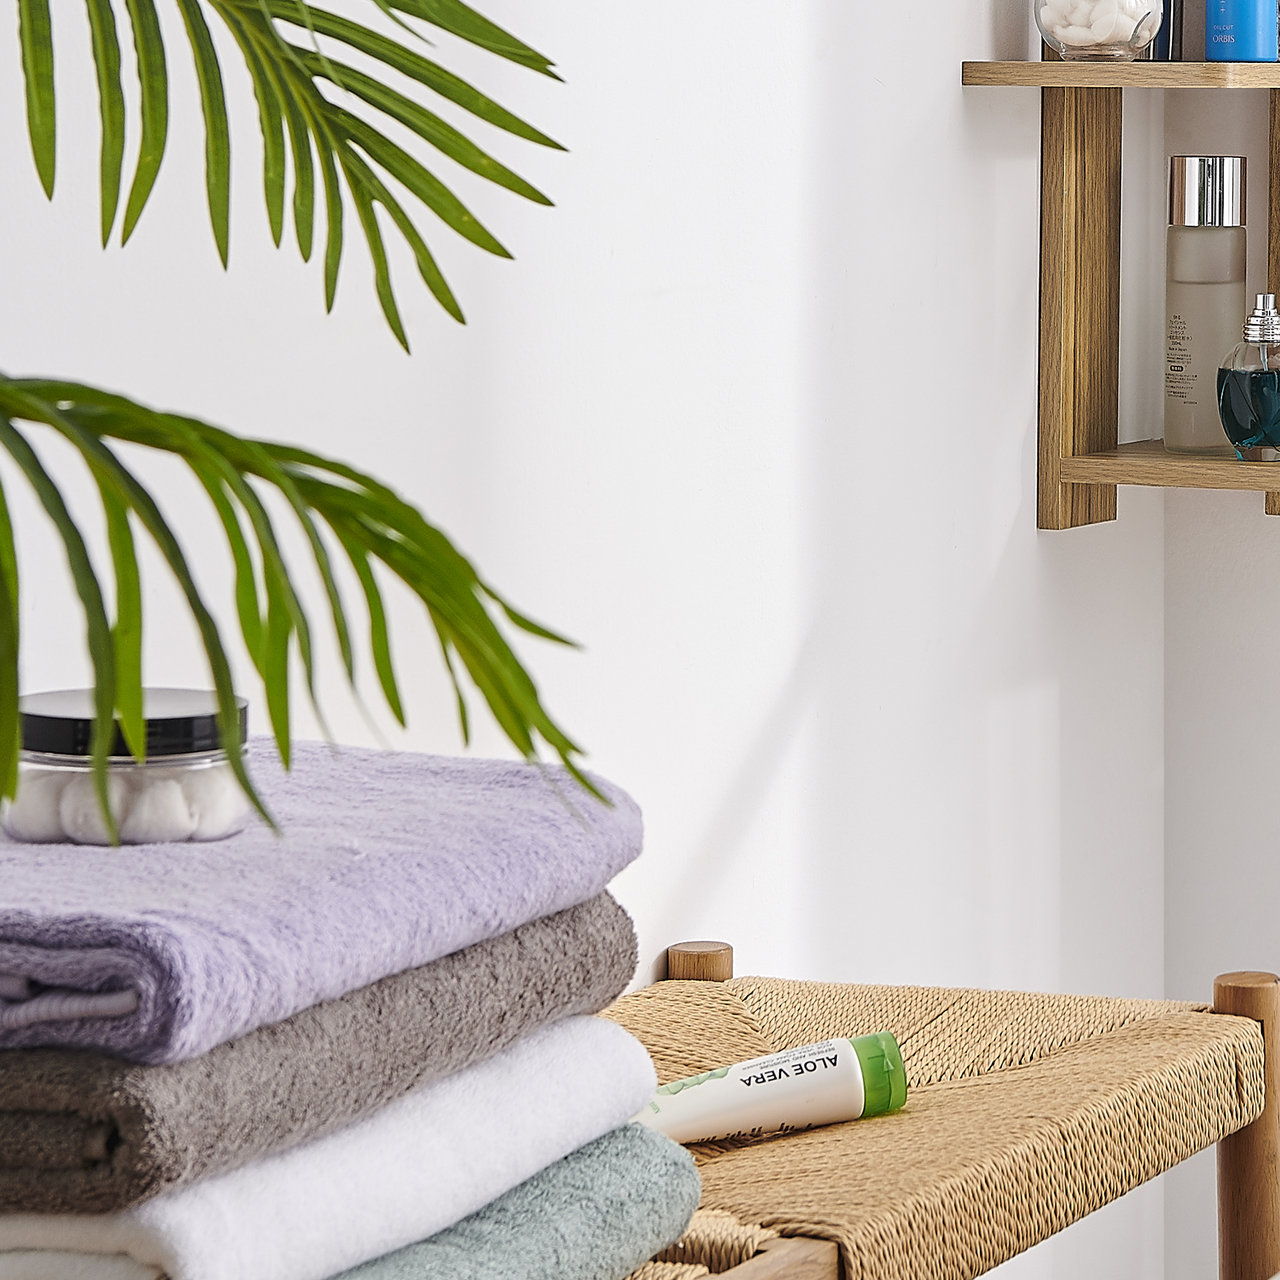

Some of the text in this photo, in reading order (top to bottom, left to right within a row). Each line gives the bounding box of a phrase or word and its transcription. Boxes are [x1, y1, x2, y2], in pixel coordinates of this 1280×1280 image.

[1212, 34, 1235, 43] ORBIS
[739, 1053, 838, 1087] ALOE VERA
